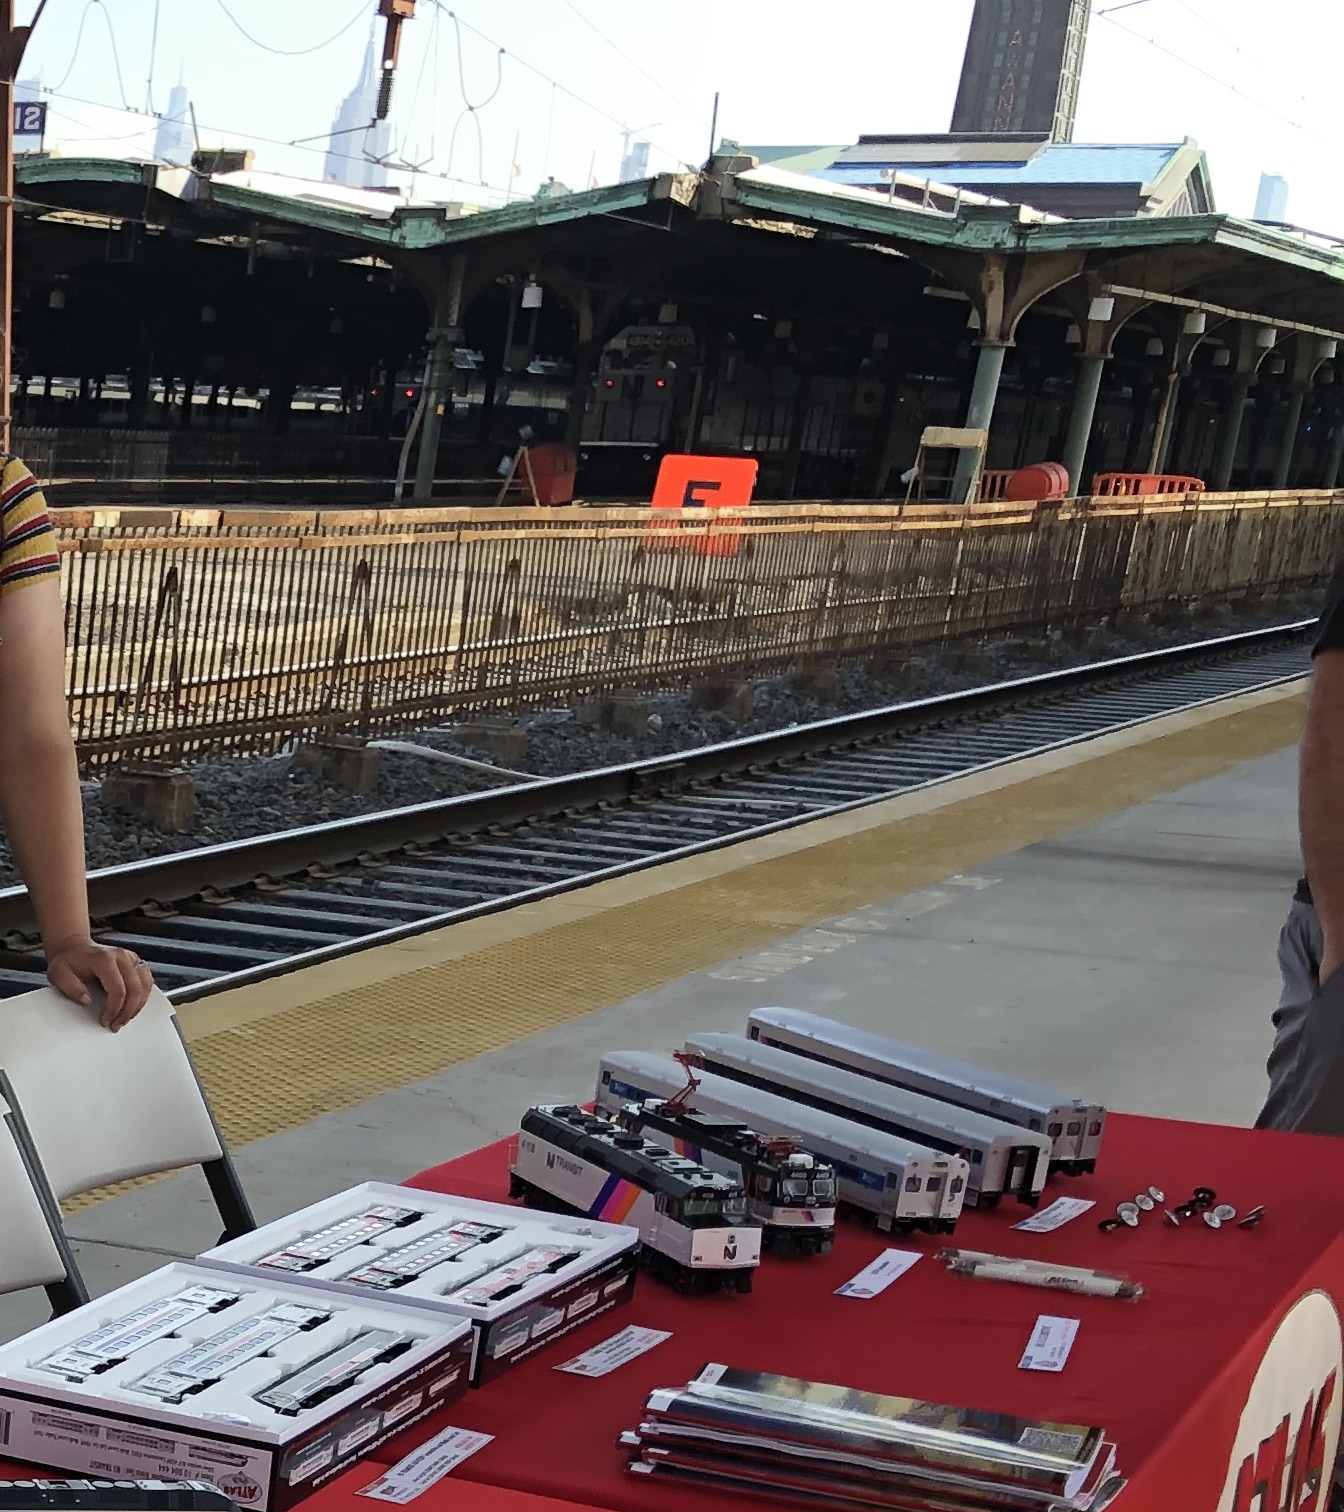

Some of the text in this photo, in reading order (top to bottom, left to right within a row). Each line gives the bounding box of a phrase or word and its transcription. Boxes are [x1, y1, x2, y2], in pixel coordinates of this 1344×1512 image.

[14, 105, 41, 130] 12
[555, 1156, 584, 1178] TRANSIT
[224, 1484, 258, 1501] ATLAS
